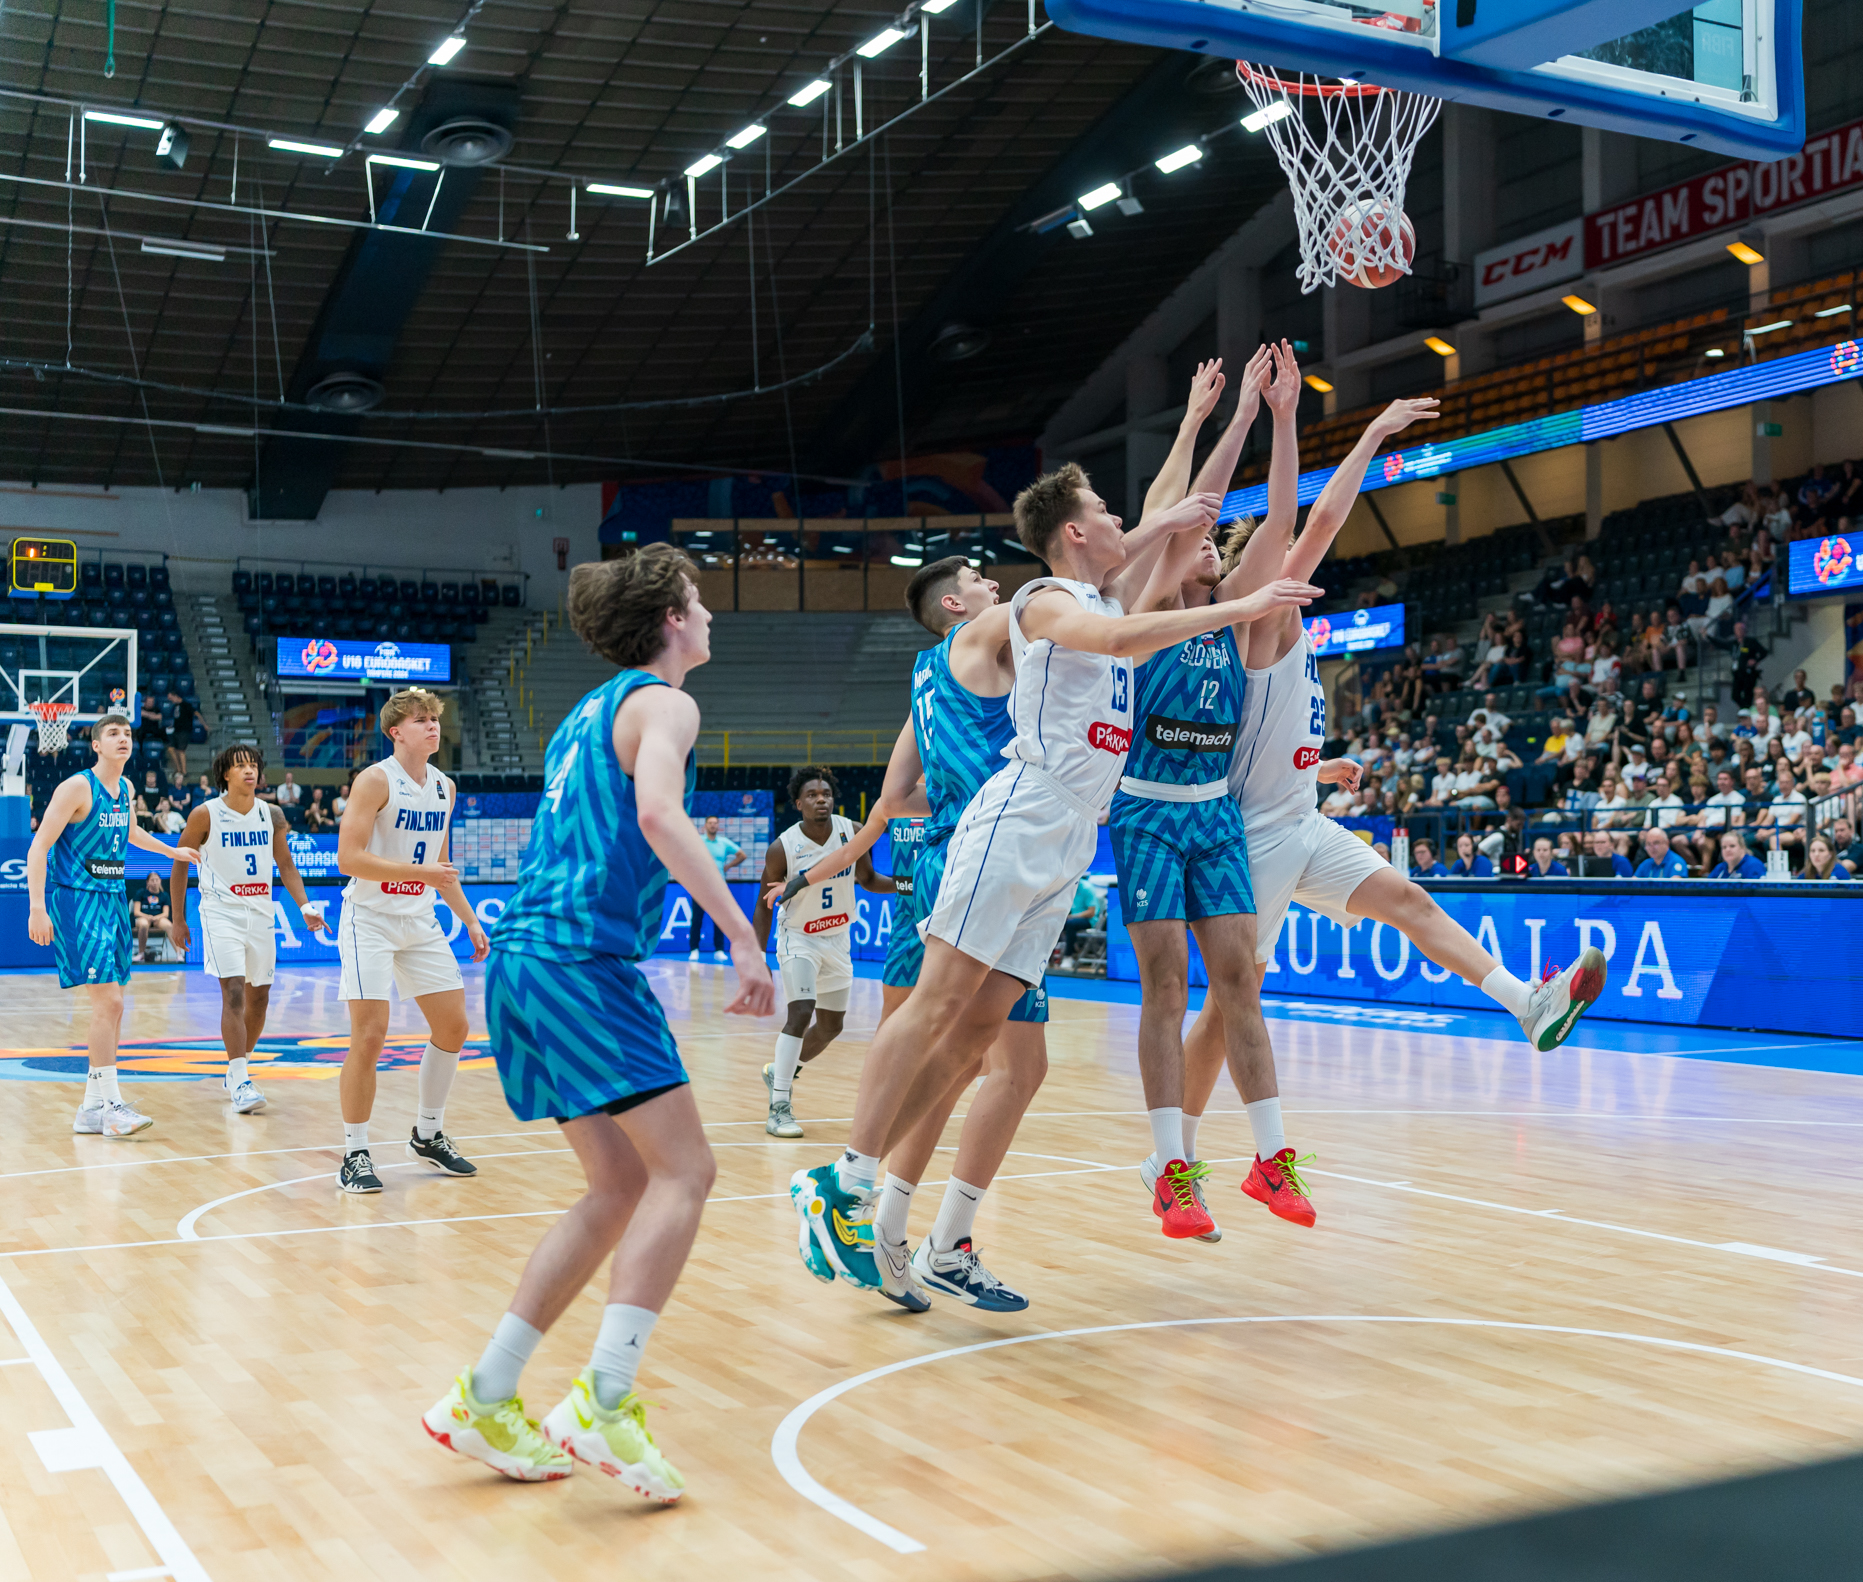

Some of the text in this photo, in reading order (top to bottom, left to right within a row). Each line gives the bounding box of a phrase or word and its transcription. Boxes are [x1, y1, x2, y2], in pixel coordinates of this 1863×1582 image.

[1596, 126, 1863, 260] TEAM SPORTIA
[1481, 235, 1574, 287] CCM
[1111, 665, 1128, 713] 13
[1200, 679, 1219, 709] 12
[1155, 724, 1232, 746] telemach
[394, 808, 446, 832] FINLAND
[112, 834, 120, 852] 5
[221, 830, 269, 848] FINLAND
[893, 826, 926, 842] SLOVEN
[244, 853, 258, 876] 3
[412, 841, 427, 865] 9
[895, 880, 913, 891] tele
[822, 887, 833, 910] 5
